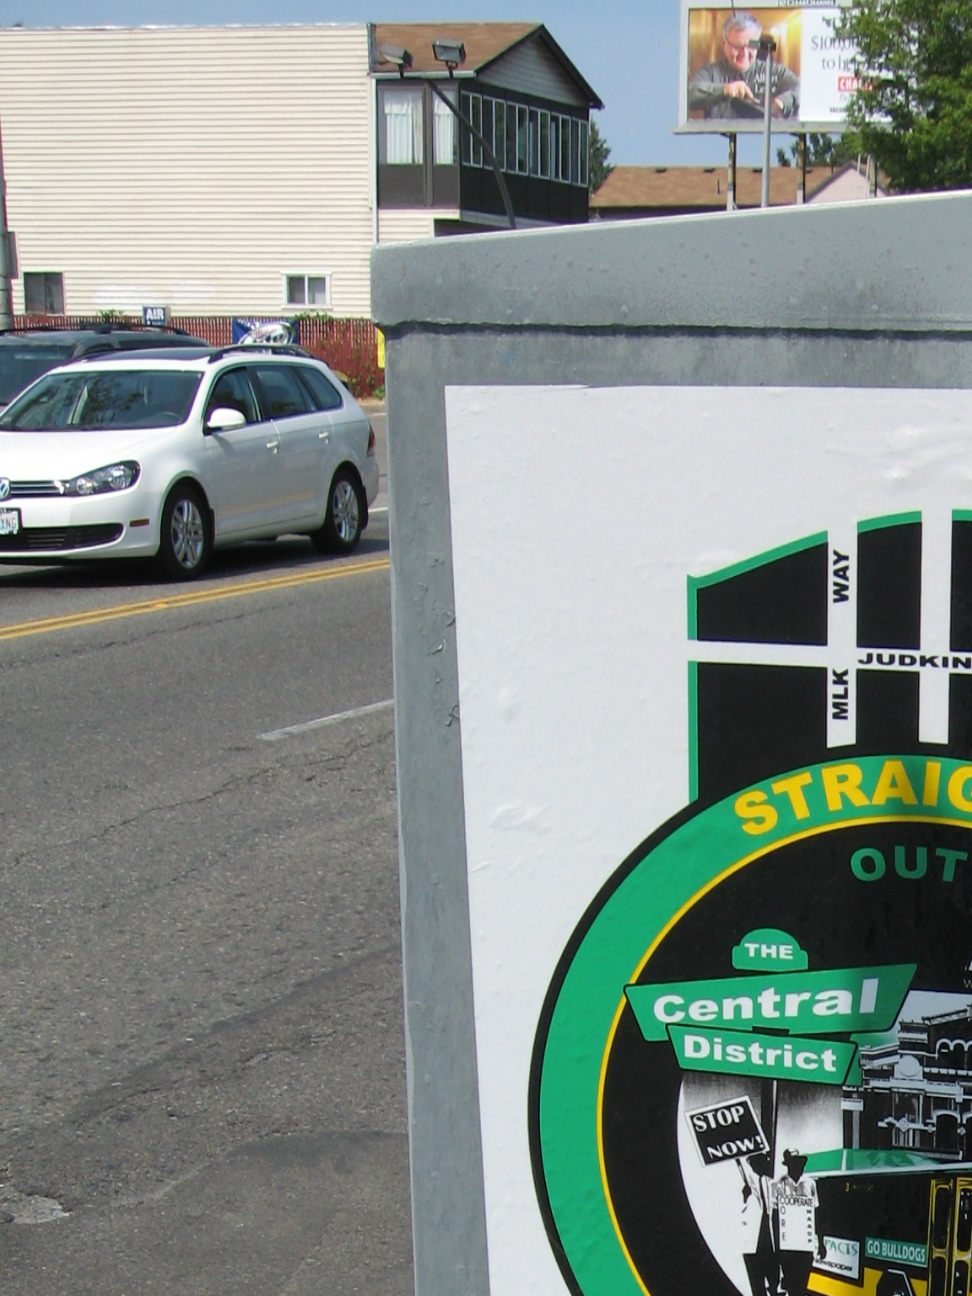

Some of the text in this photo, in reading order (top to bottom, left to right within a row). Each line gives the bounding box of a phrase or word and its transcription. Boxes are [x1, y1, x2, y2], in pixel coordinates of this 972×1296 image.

[146, 307, 164, 320] AIR
[832, 549, 850, 721] MLK WAY
[850, 846, 968, 883] OUT
[744, 942, 794, 960] THE
[653, 977, 879, 1024] Central
[684, 1035, 838, 1073] District
[694, 1105, 745, 1134] STOP
[706, 1136, 764, 1160] NOW!
[867, 1240, 926, 1262] GO BULLDOGS
